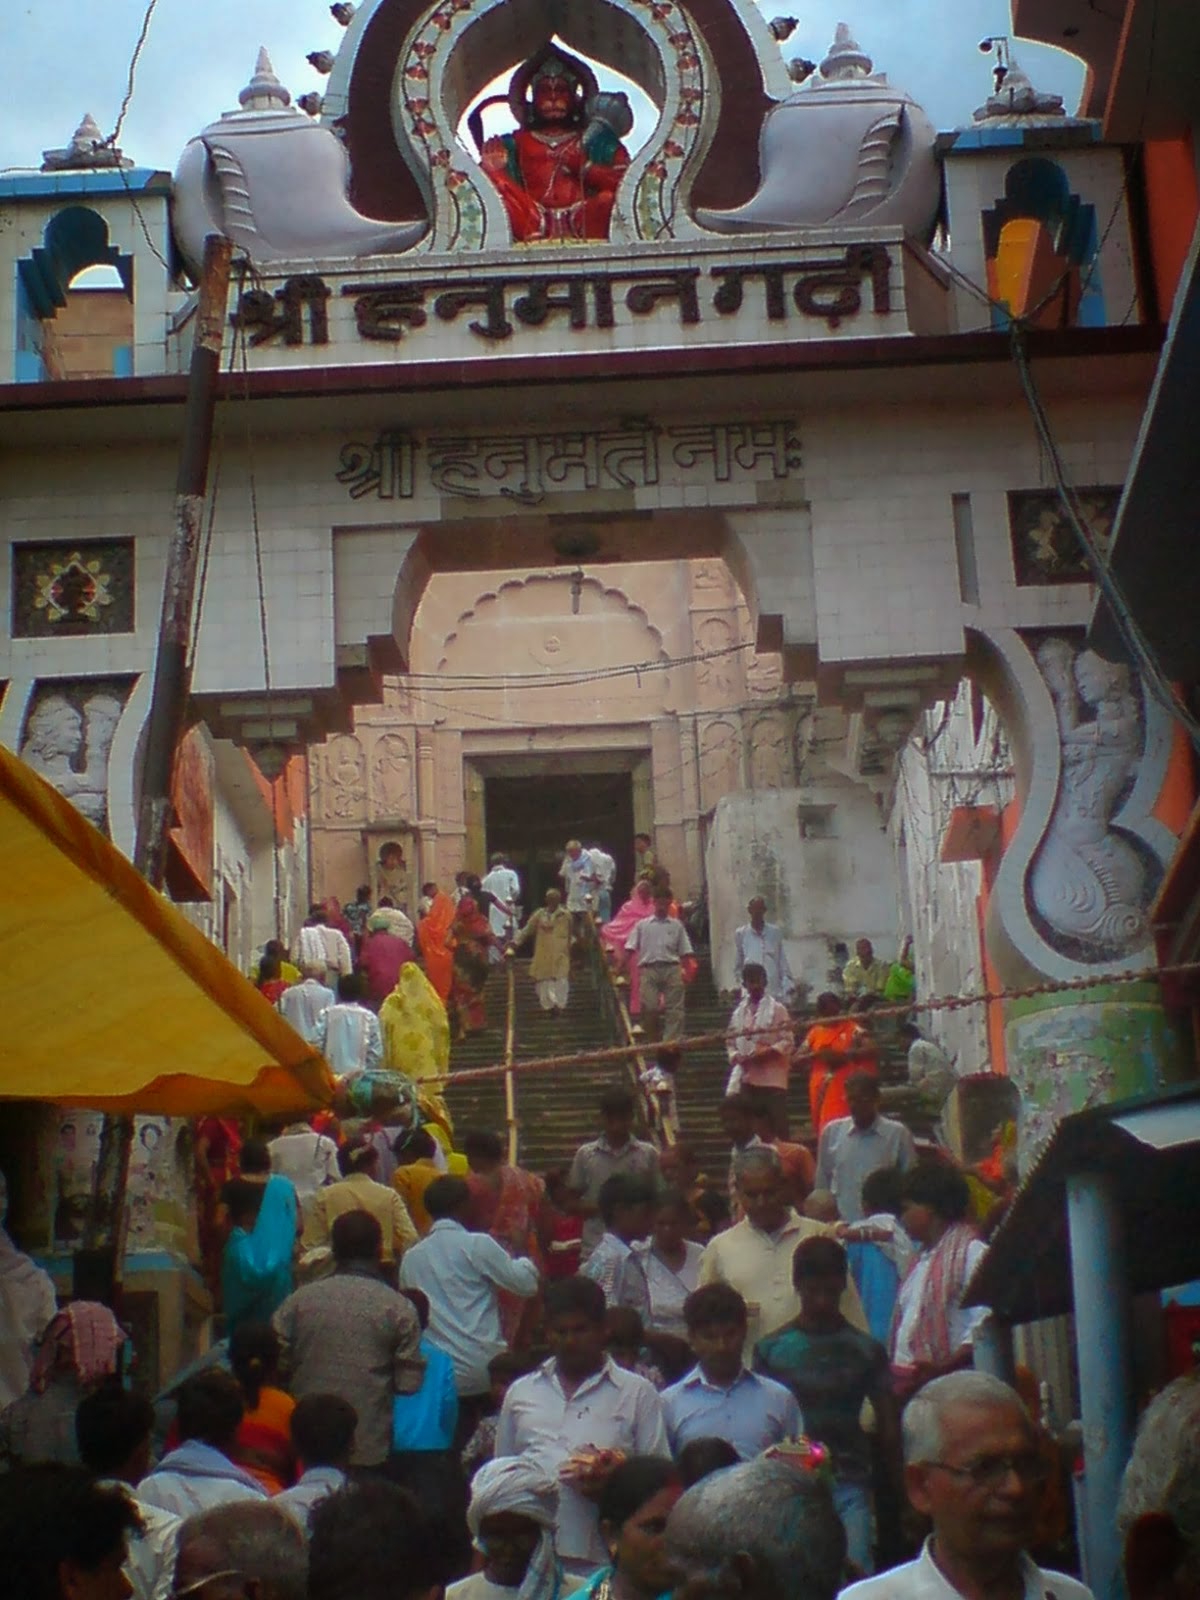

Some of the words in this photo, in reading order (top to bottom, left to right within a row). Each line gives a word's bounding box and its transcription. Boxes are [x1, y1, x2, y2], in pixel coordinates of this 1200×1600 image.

[229, 275, 331, 344] श्री
[341, 267, 699, 339] हनुमान
[335, 430, 421, 500] श्री
[425, 416, 662, 505] हनुमते
[666, 420, 802, 482] नमः
